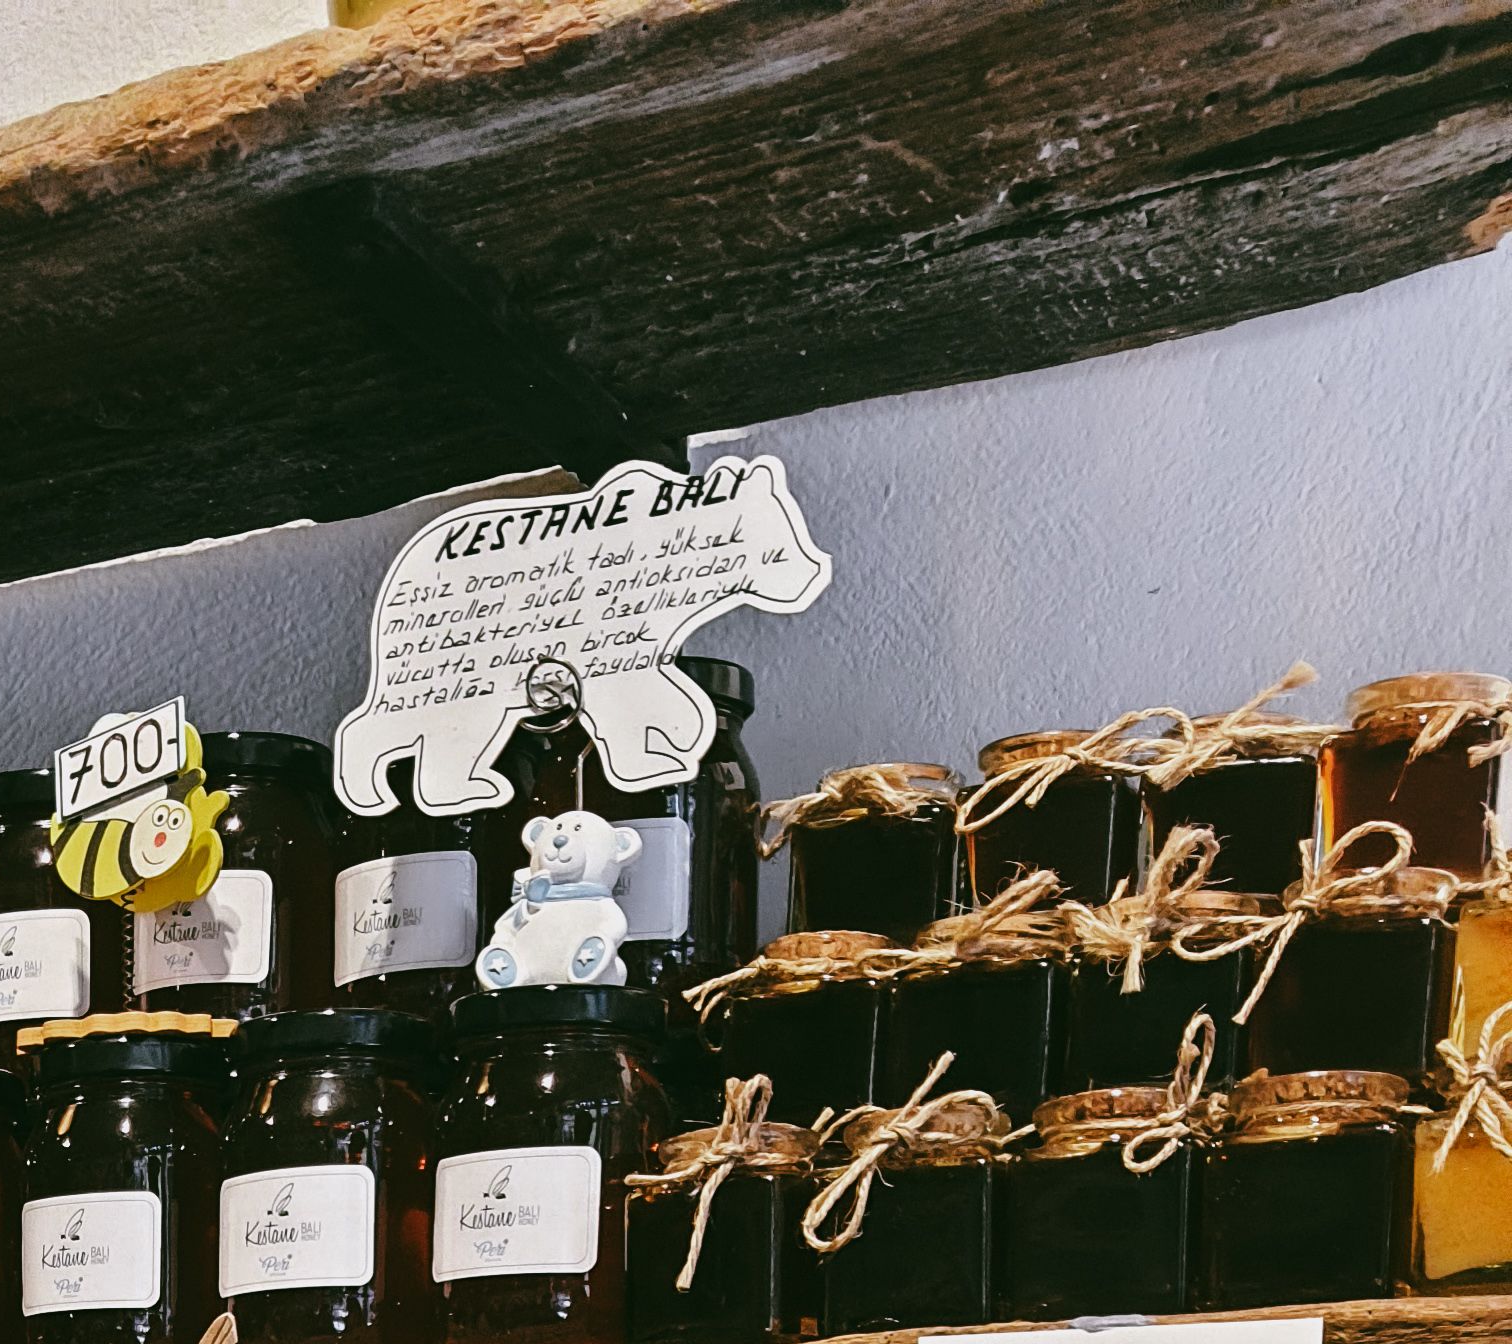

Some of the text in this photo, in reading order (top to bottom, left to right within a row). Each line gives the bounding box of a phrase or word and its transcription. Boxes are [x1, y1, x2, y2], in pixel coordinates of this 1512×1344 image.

[434, 488, 635, 563] KESTANE
[465, 514, 745, 594] aromatik yüksek
[595, 553, 747, 597] antioksidan
[761, 547, 789, 565] ve
[386, 608, 585, 660] antibakteriyel
[387, 652, 476, 687] vücutta
[153, 919, 201, 945] Kestane
[353, 909, 403, 937] Kestane
[459, 1203, 519, 1231] Kestane
[244, 1220, 299, 1248] Kestane
[41, 1243, 90, 1271] Kestane
